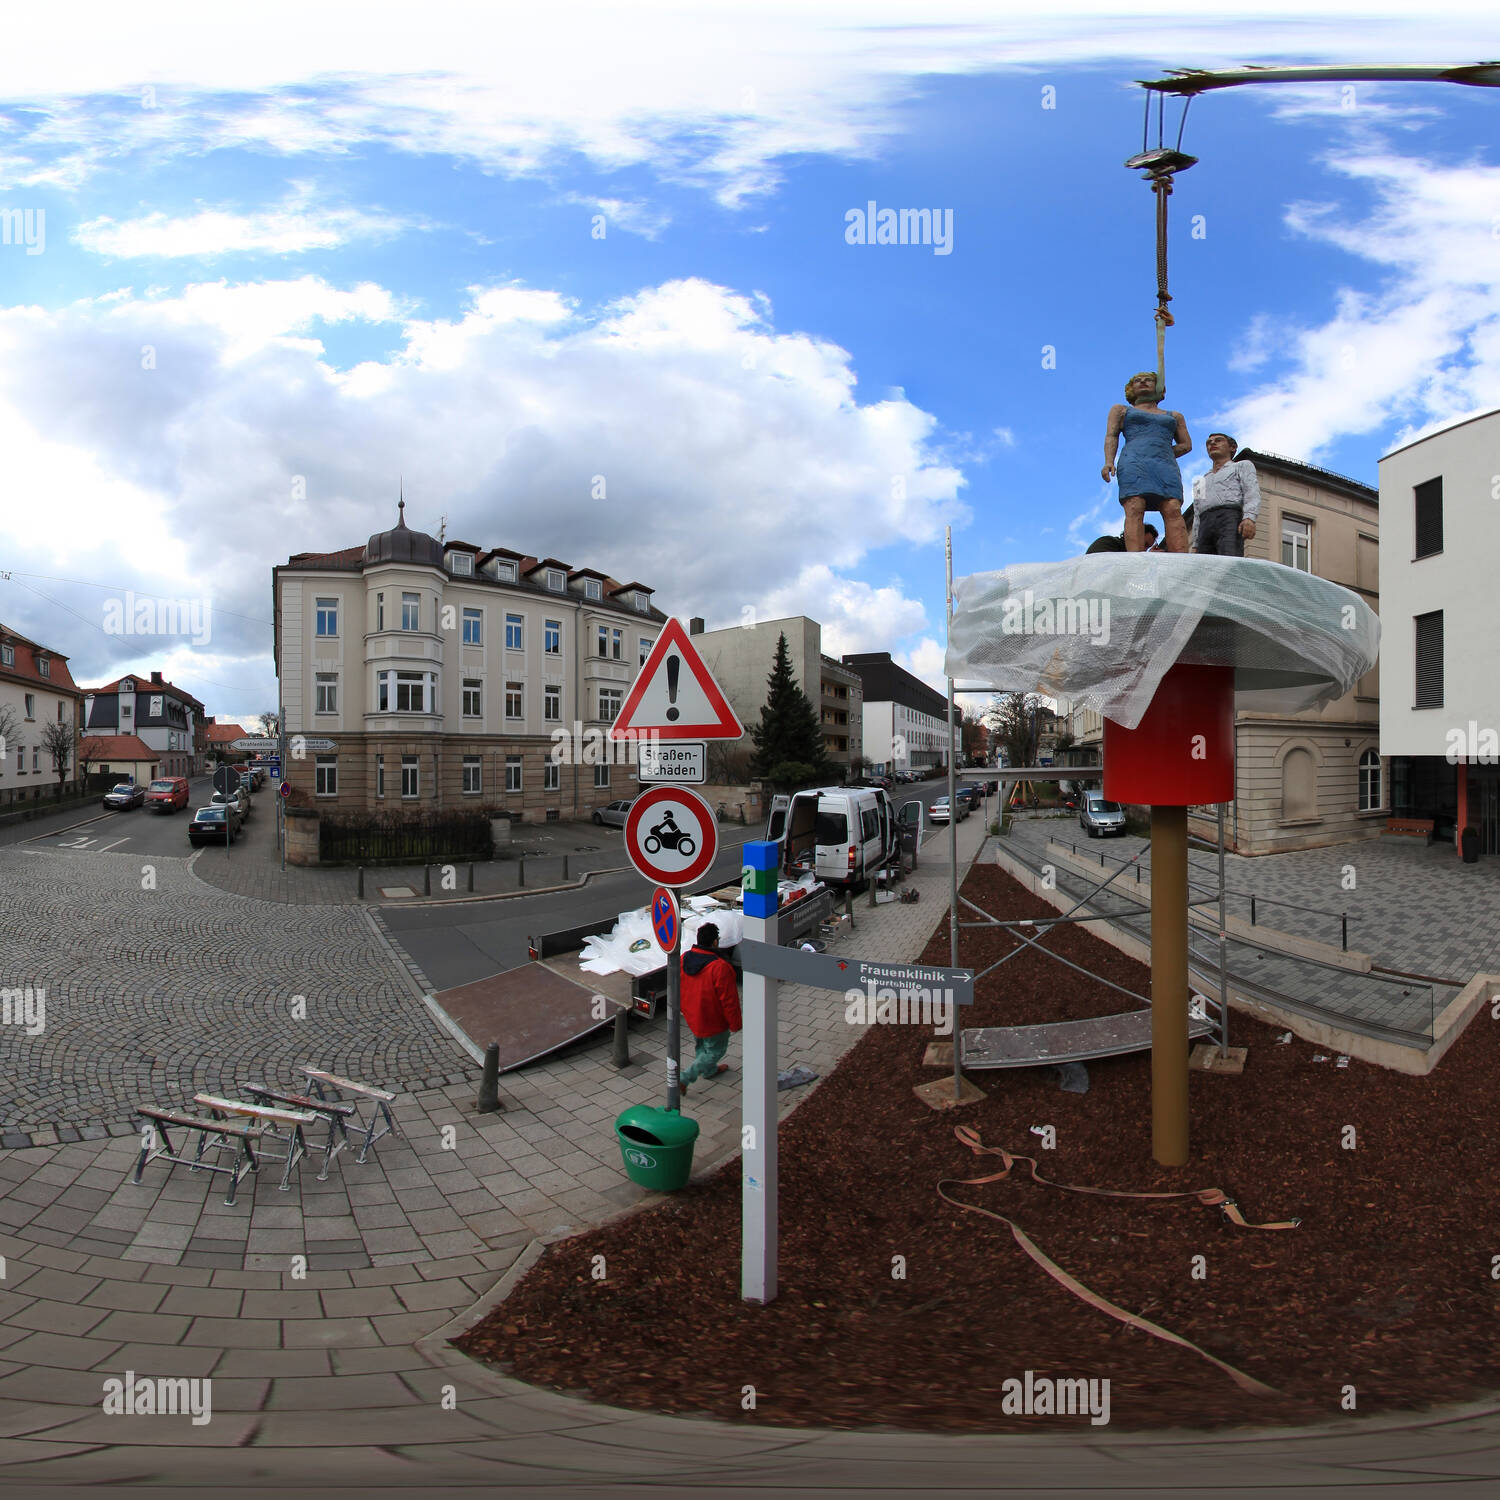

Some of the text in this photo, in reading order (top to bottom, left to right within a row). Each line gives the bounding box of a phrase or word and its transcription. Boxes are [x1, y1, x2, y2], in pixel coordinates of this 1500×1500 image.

[645, 749, 698, 761] Straßen-
[647, 764, 696, 776] schäden
[859, 963, 945, 982] Frauenklinik
